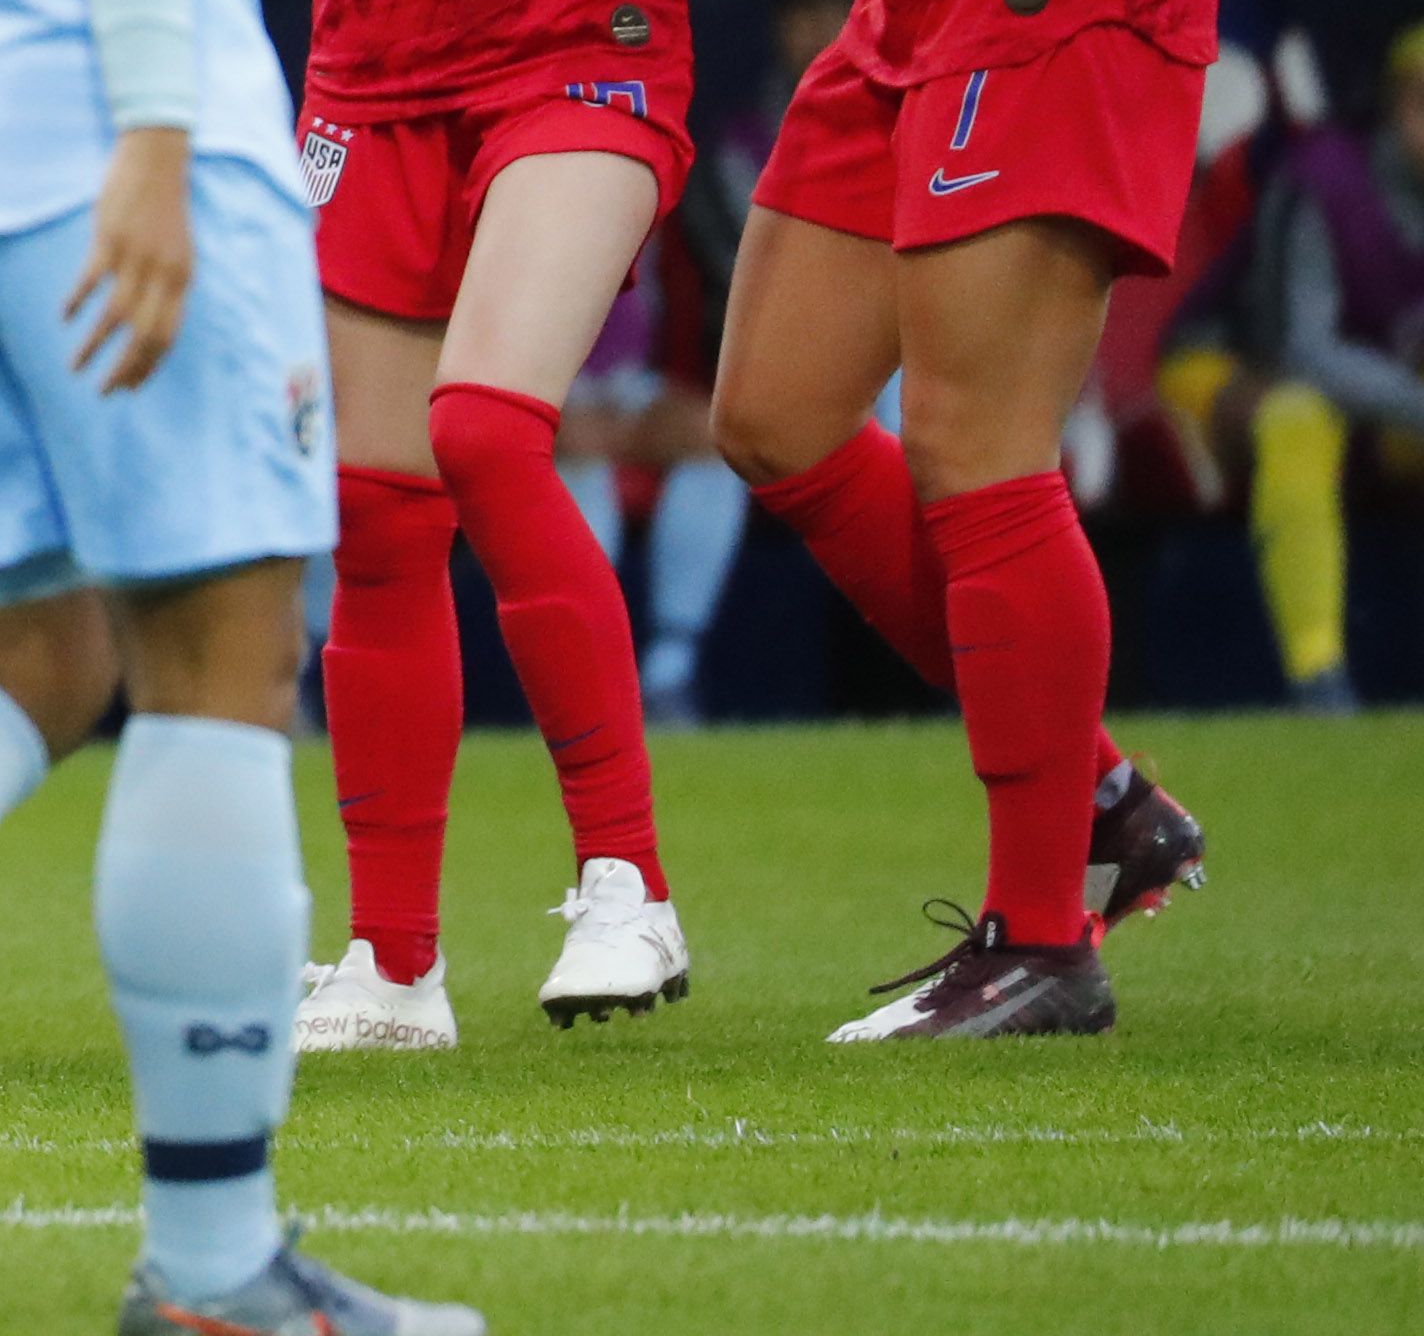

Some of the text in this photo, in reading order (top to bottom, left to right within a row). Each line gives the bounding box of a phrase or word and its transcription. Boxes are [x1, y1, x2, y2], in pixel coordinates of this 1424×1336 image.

[307, 136, 342, 169] USA
[296, 1012, 450, 1048] new balance
